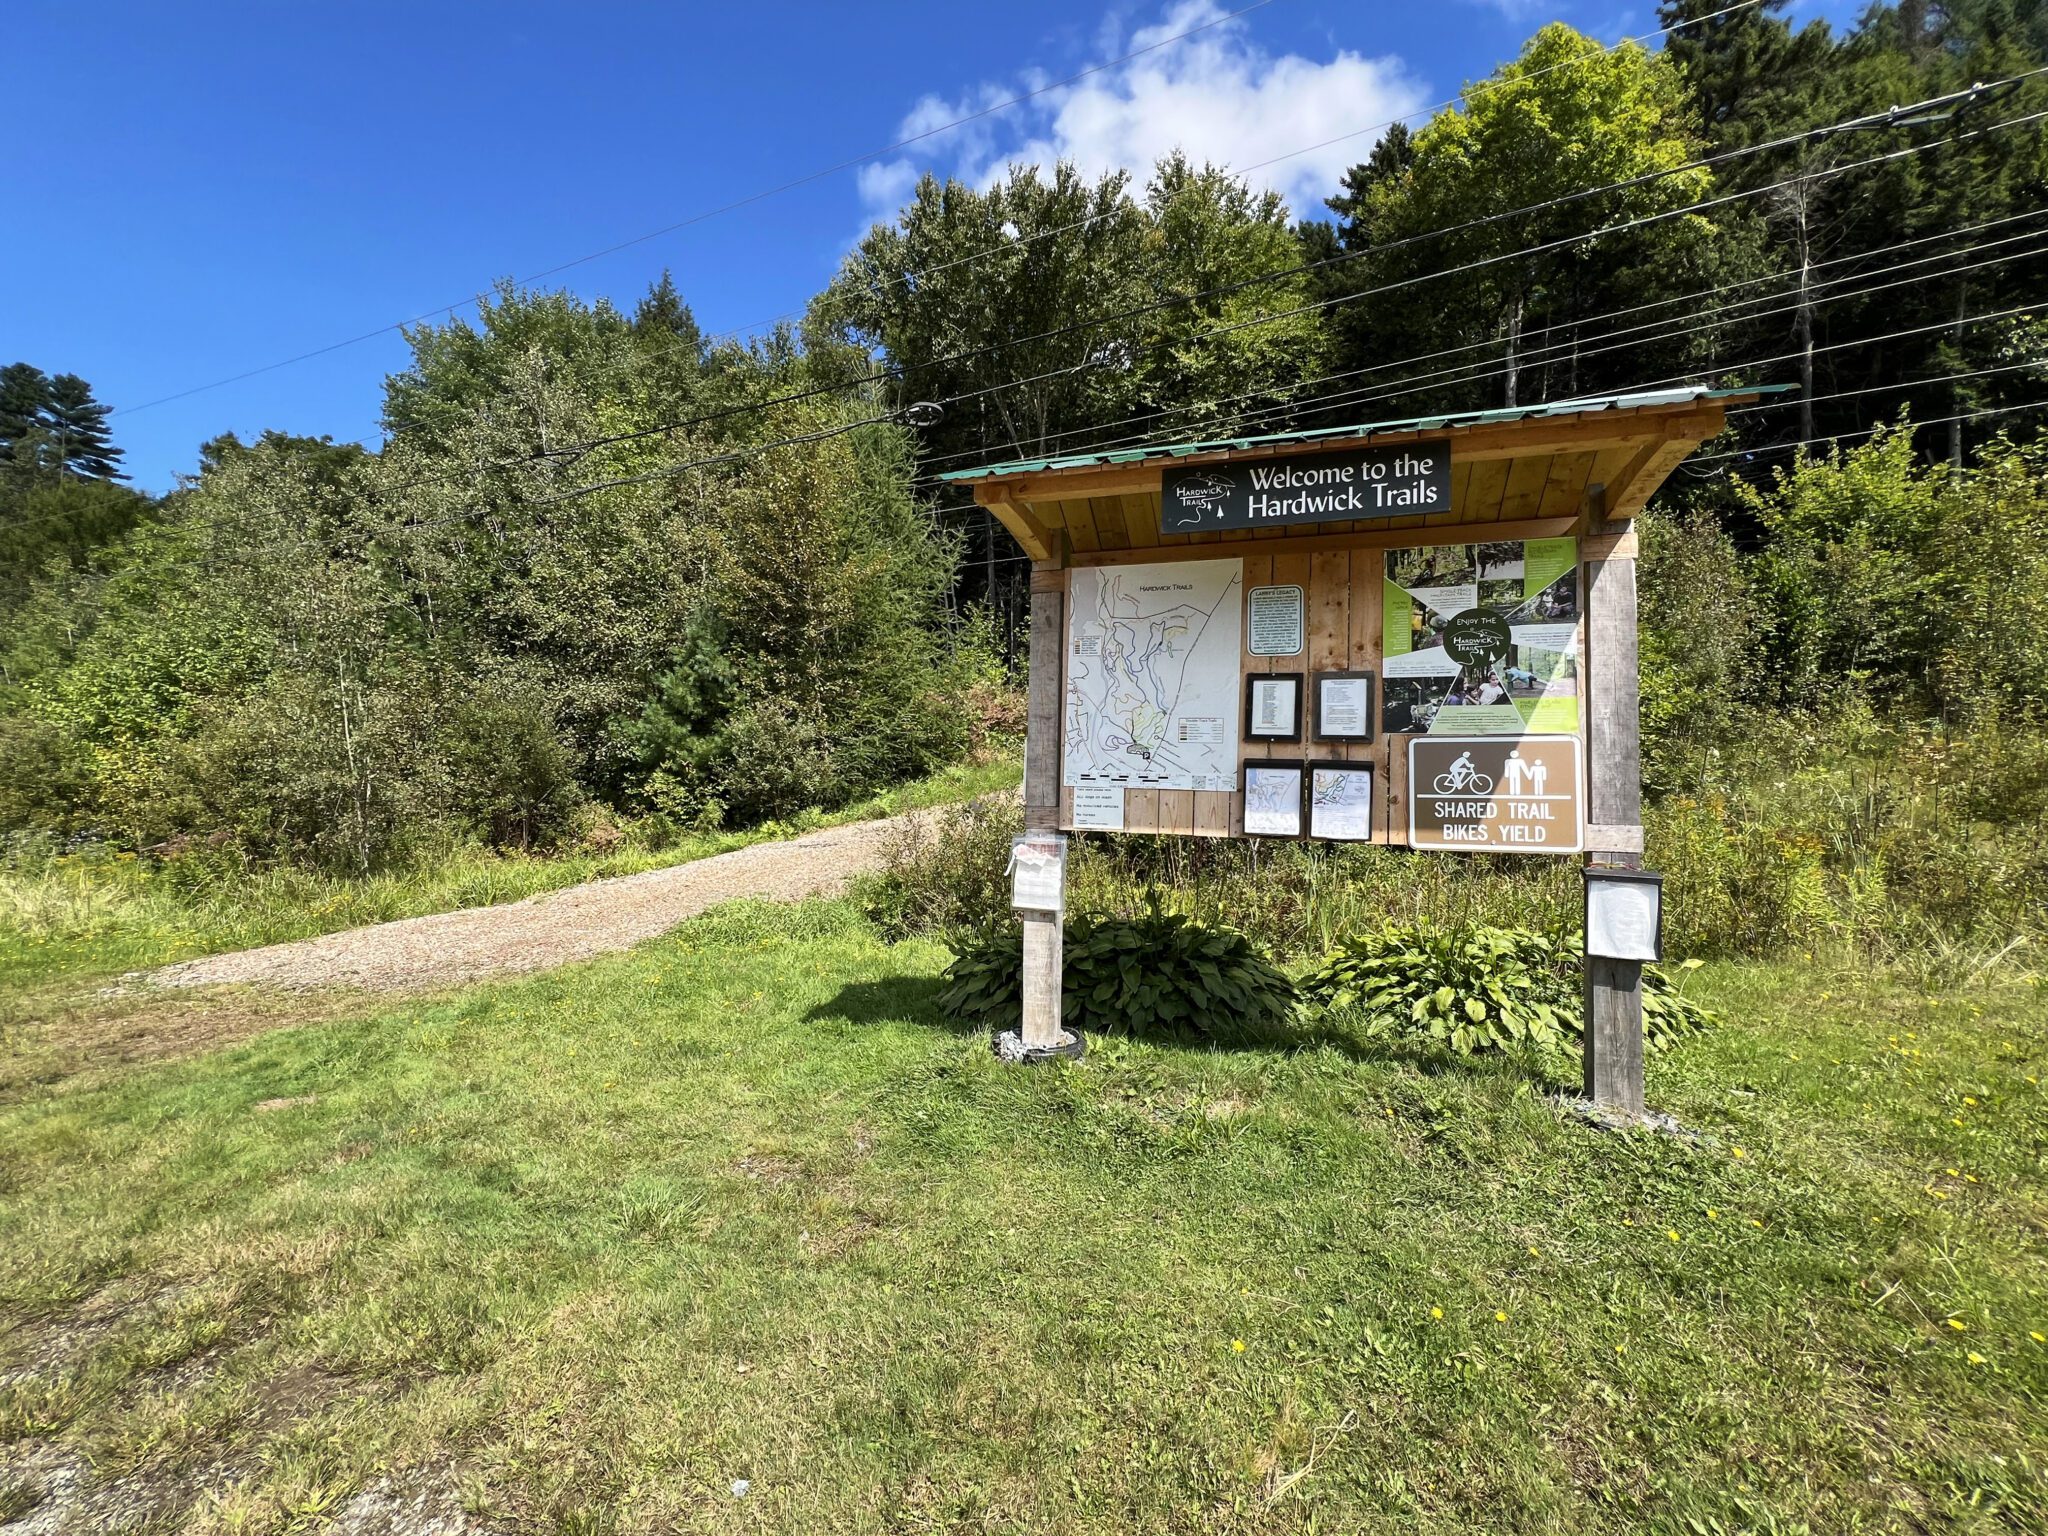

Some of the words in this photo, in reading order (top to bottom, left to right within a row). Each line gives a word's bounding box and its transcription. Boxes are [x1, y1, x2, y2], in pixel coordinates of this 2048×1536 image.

[1249, 464, 1354, 491] Welcome
[1361, 462, 1387, 481] to
[1393, 453, 1434, 478] the
[1176, 485, 1223, 497] HARDWICK
[1180, 496, 1207, 509] TRAILS
[1248, 486, 1363, 519] Hardwick
[1371, 480, 1438, 508] Trails
[1456, 617, 1479, 626] ENJOY
[1480, 616, 1497, 625] THE
[1453, 635, 1493, 645] HARDWICK
[1457, 644, 1480, 654] TRAILS
[1434, 801, 1498, 819] SHARED
[1508, 802, 1555, 820] TRAIL
[1443, 824, 1488, 841] BIKES
[1498, 824, 1546, 843] YIELD
